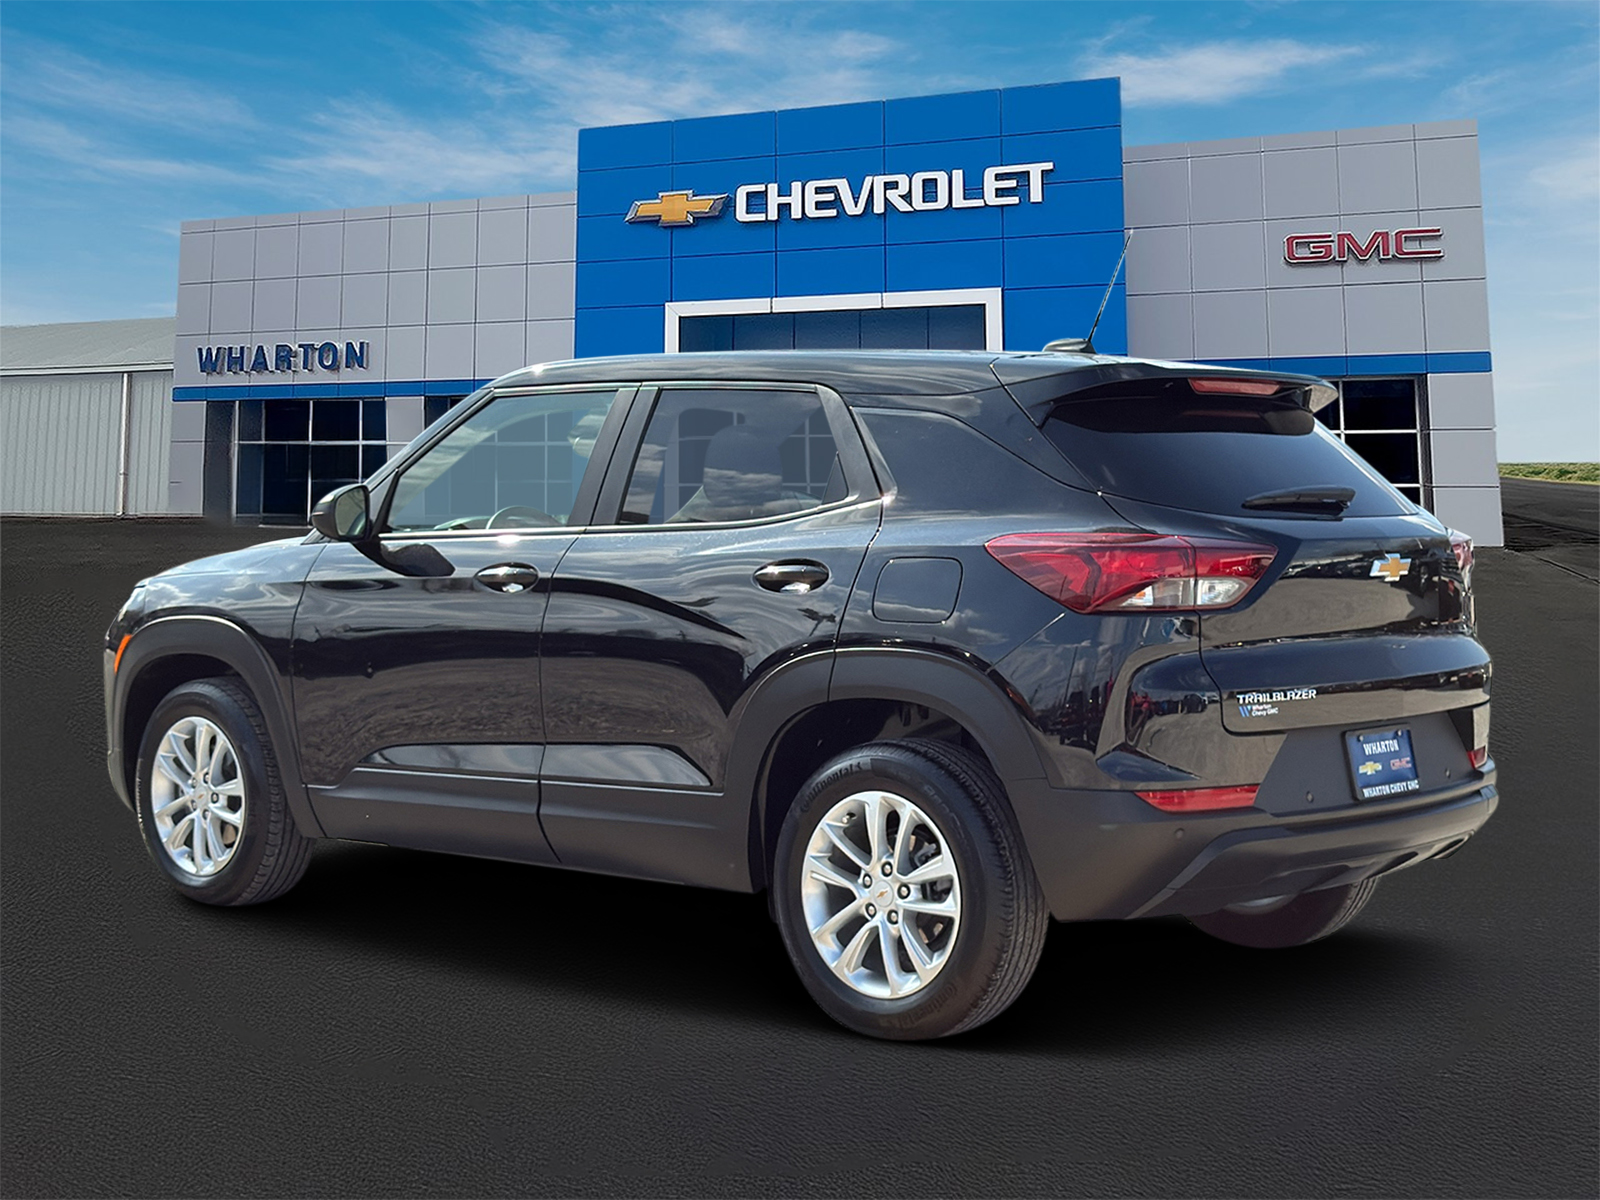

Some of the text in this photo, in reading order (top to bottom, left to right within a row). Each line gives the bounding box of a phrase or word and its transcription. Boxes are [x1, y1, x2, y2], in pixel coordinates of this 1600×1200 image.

[735, 162, 1054, 223] CHEVROLET
[1284, 227, 1443, 263] GMC
[197, 341, 368, 373] WHARTON
[1237, 689, 1317, 704] TRAILBLAZER
[1363, 739, 1399, 756] WHARTON
[1390, 757, 1412, 770] GMC
[1363, 779, 1419, 798] WHARTON CHEVY GMC
